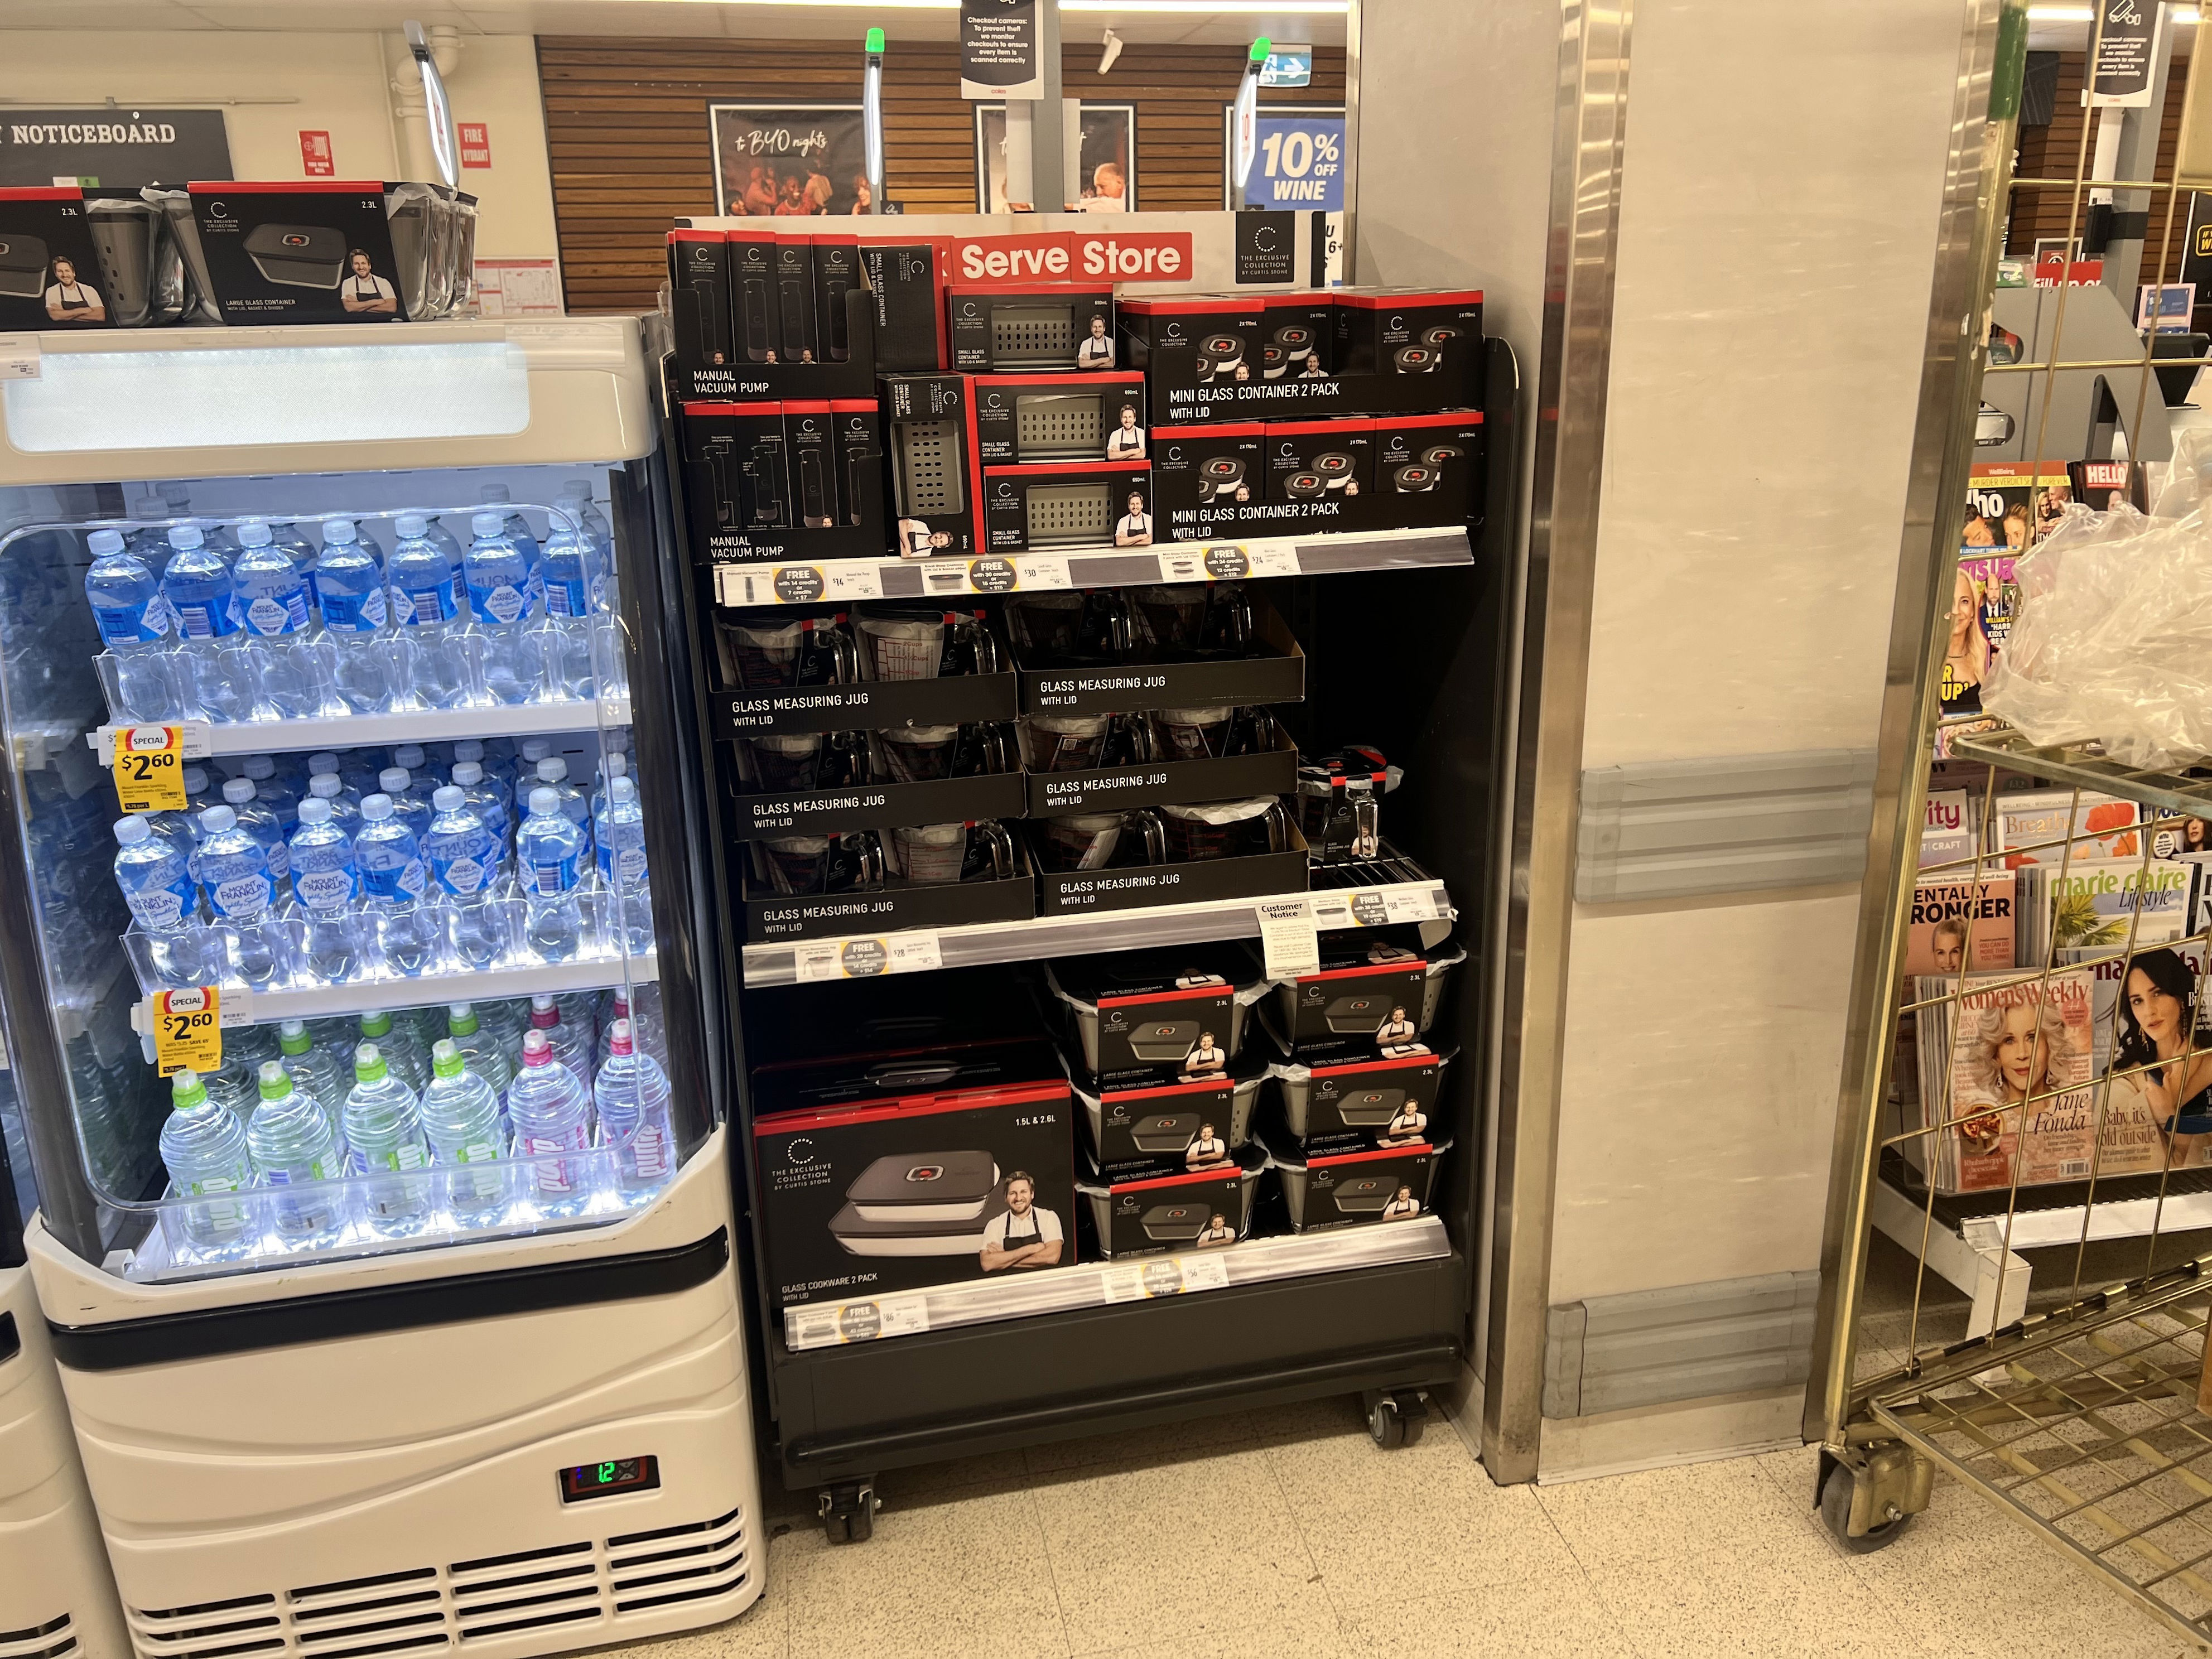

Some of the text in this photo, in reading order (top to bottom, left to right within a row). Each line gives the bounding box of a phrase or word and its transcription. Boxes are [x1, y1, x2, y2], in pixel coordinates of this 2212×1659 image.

[11, 124, 176, 144] NOTICEBOARD
[463, 128, 483, 143] FIRE
[748, 129, 828, 157] BYO nights
[1314, 164, 1338, 177] OFF
[1274, 181, 1327, 200] WINE
[961, 240, 1182, 278] Serve Store
[693, 370, 735, 382] MANUAL
[694, 382, 769, 394] VACUUM PUMP
[1170, 382, 1339, 402] MINI GLASS CONTAINER 2 PACK
[1170, 407, 1209, 419] WITH LID
[1172, 502, 1339, 523] MINI GLASS CONTAINER 2 PACK
[1172, 526, 1212, 539] WITH LID
[710, 536, 751, 547] MANUAL
[711, 546, 784, 558] VACUUM PUMP
[1215, 549, 1236, 558] FREE
[981, 562, 1003, 571] FREE
[786, 571, 810, 580] FREE
[1040, 676, 1165, 693] GLASS MEASURING JUG
[732, 693, 869, 713] GLASS MEASURING JUG
[1040, 696, 1077, 706] WITH LID
[734, 715, 773, 726] WITH LID
[1047, 773, 1167, 794] GLASS MEASURING JUG
[753, 795, 885, 816] GLASS MEASURING JUG
[1933, 841, 1960, 851] CRAFT
[451, 865, 477, 874] FRANKLIN
[229, 880, 257, 894] MOUNT
[304, 880, 346, 891] FRANKLIN
[311, 876, 338, 885] MOUNT
[1061, 874, 1179, 894] GLASS MEASURING JUG
[2051, 867, 2186, 897] marie claire
[221, 883, 264, 899] FRANKLIN
[1914, 885, 1989, 903] ENTALLY
[2119, 884, 2171, 911] Lifestyle
[1360, 896, 1379, 904] FREE
[764, 901, 894, 922] GLASS MEASURING JUG
[1261, 903, 1303, 913] Customer
[1910, 898, 2011, 924] RONGER
[853, 943, 874, 953] FREE
[894, 949, 905, 957] $28
[171, 997, 202, 1006] SPECIAL
[2054, 1092, 2089, 1115] Jane
[1015, 1116, 1030, 1126] 1.5L
[1033, 1116, 1038, 1125] &
[2034, 1109, 2086, 1135] Fonda
[2104, 1106, 2146, 1126] Baby, it's
[2120, 1127, 2156, 1145] outside
[632, 1125, 667, 1177] pump
[789, 1163, 832, 1175] EXCLUSIVE
[777, 1171, 828, 1184] COLLECTION
[784, 1178, 831, 1189] CURTIS STONE
[1151, 1263, 1170, 1274] FREE
[782, 1283, 806, 1294] GLASS
[808, 1277, 850, 1290] COOKWARE
[858, 1272, 878, 1283] PACK
[850, 1306, 870, 1317] FREE
[599, 1462, 615, 1483] 12
